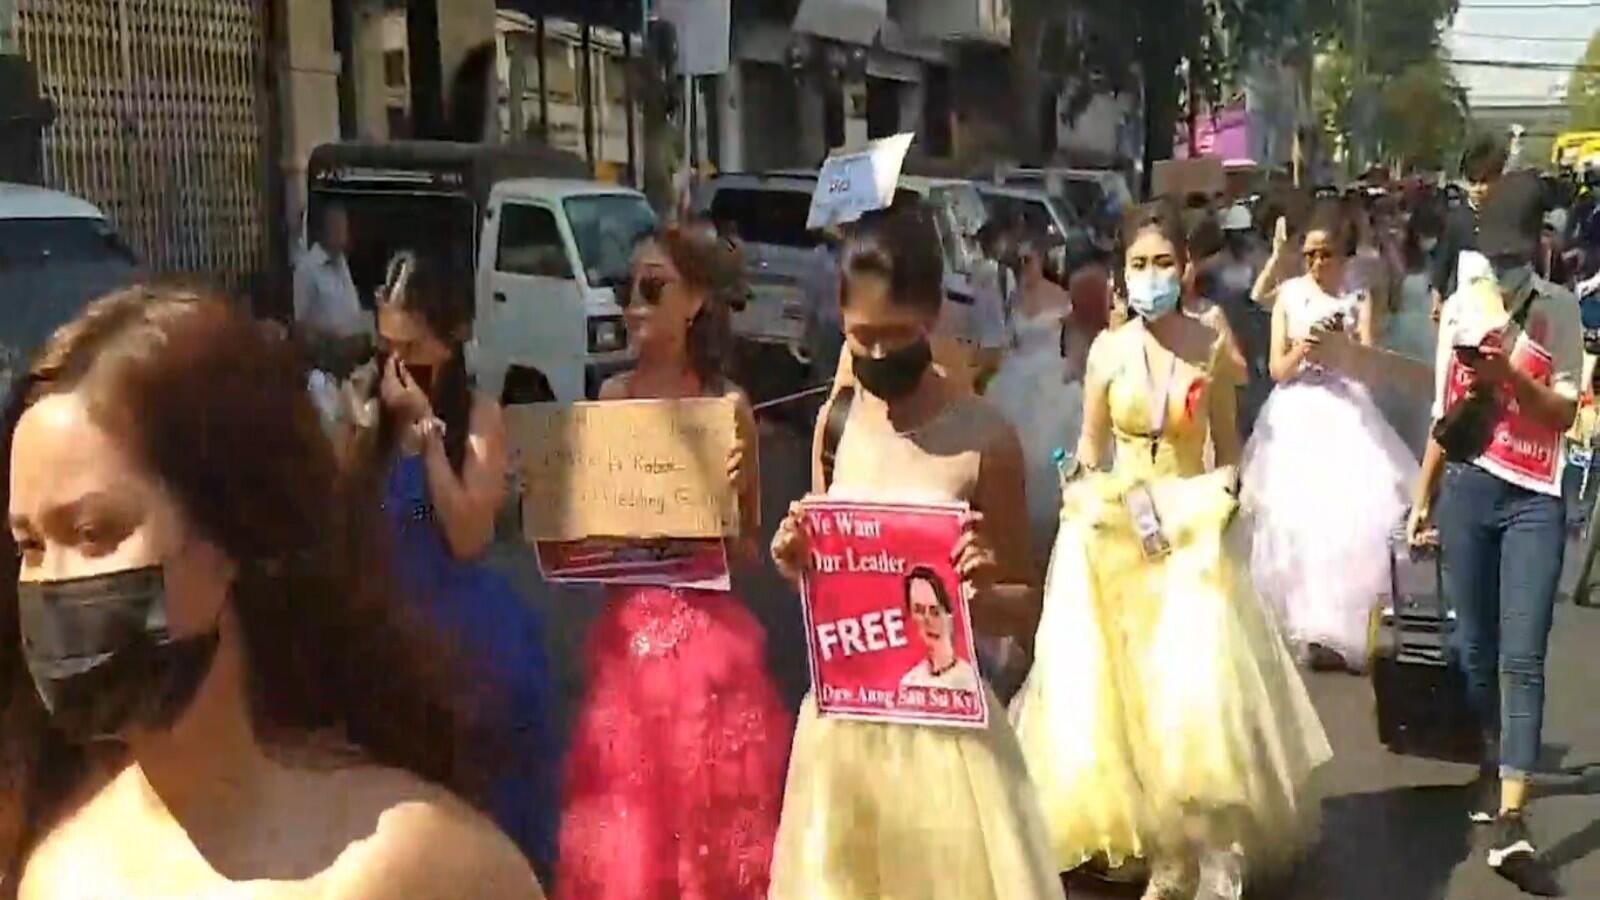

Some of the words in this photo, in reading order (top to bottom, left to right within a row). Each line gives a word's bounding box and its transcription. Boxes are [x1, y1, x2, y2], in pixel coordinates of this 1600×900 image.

[834, 512, 882, 540] Want
[846, 548, 906, 574] Leader
[816, 608, 908, 661] FREE
[858, 686, 895, 708] Aung
[898, 687, 927, 707] San
